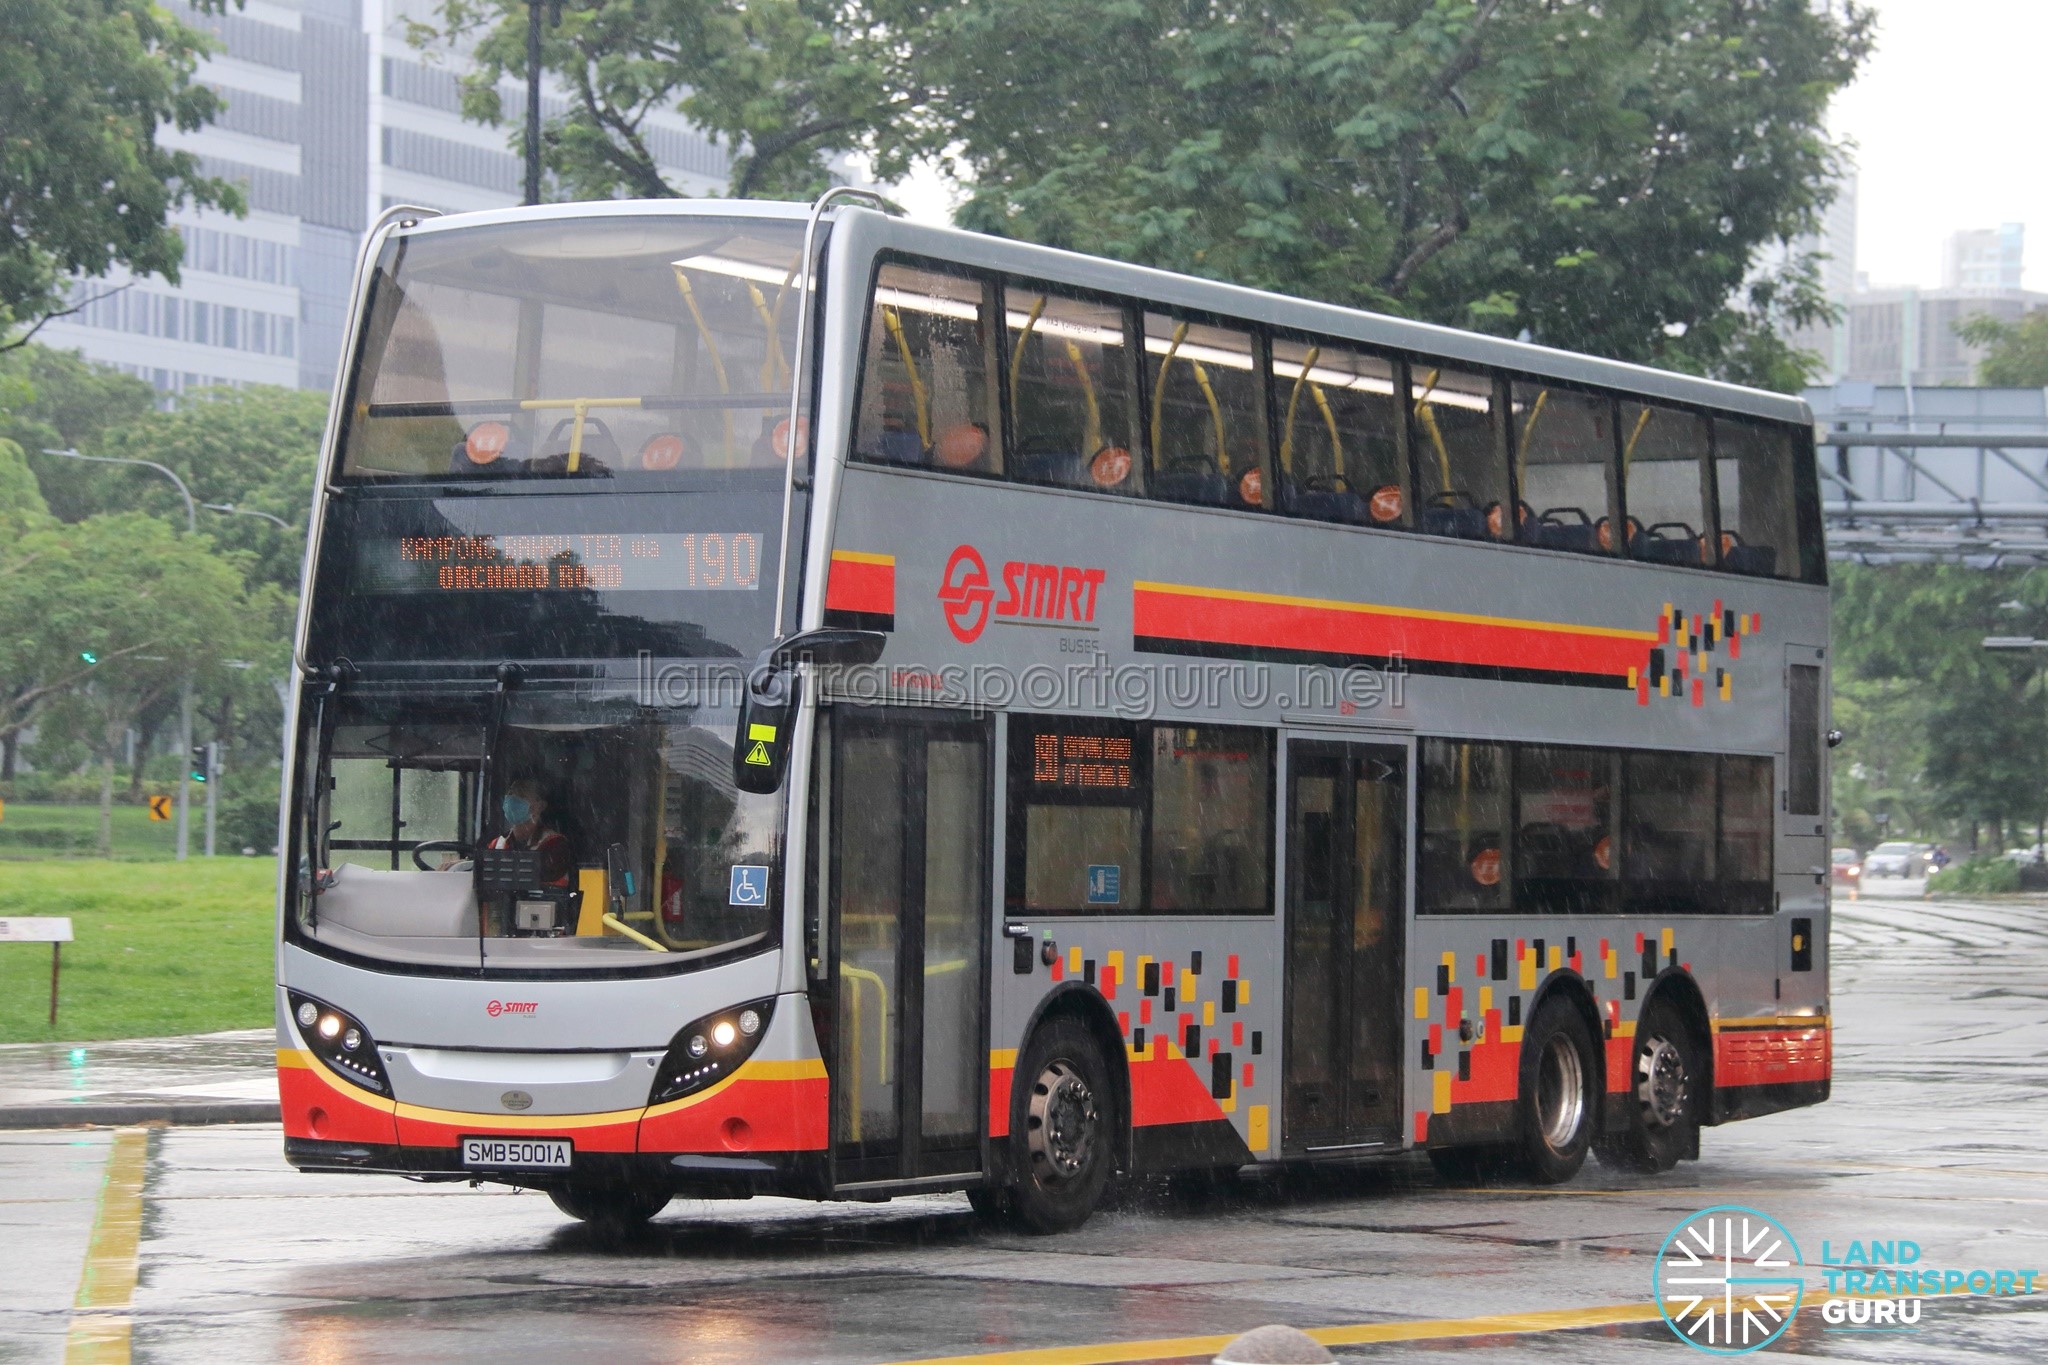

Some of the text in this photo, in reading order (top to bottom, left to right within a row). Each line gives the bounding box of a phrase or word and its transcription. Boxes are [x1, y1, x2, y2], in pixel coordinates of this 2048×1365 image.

[401, 535, 496, 561] KAMPONG
[579, 534, 622, 559] TER
[683, 532, 757, 587] 190
[438, 563, 622, 590] ORCHARD ROAD
[995, 561, 1106, 623] SMRT
[1059, 637, 1100, 654] BUSES
[503, 1001, 539, 1013] SMRT
[468, 1142, 566, 1164] SMB5001A
